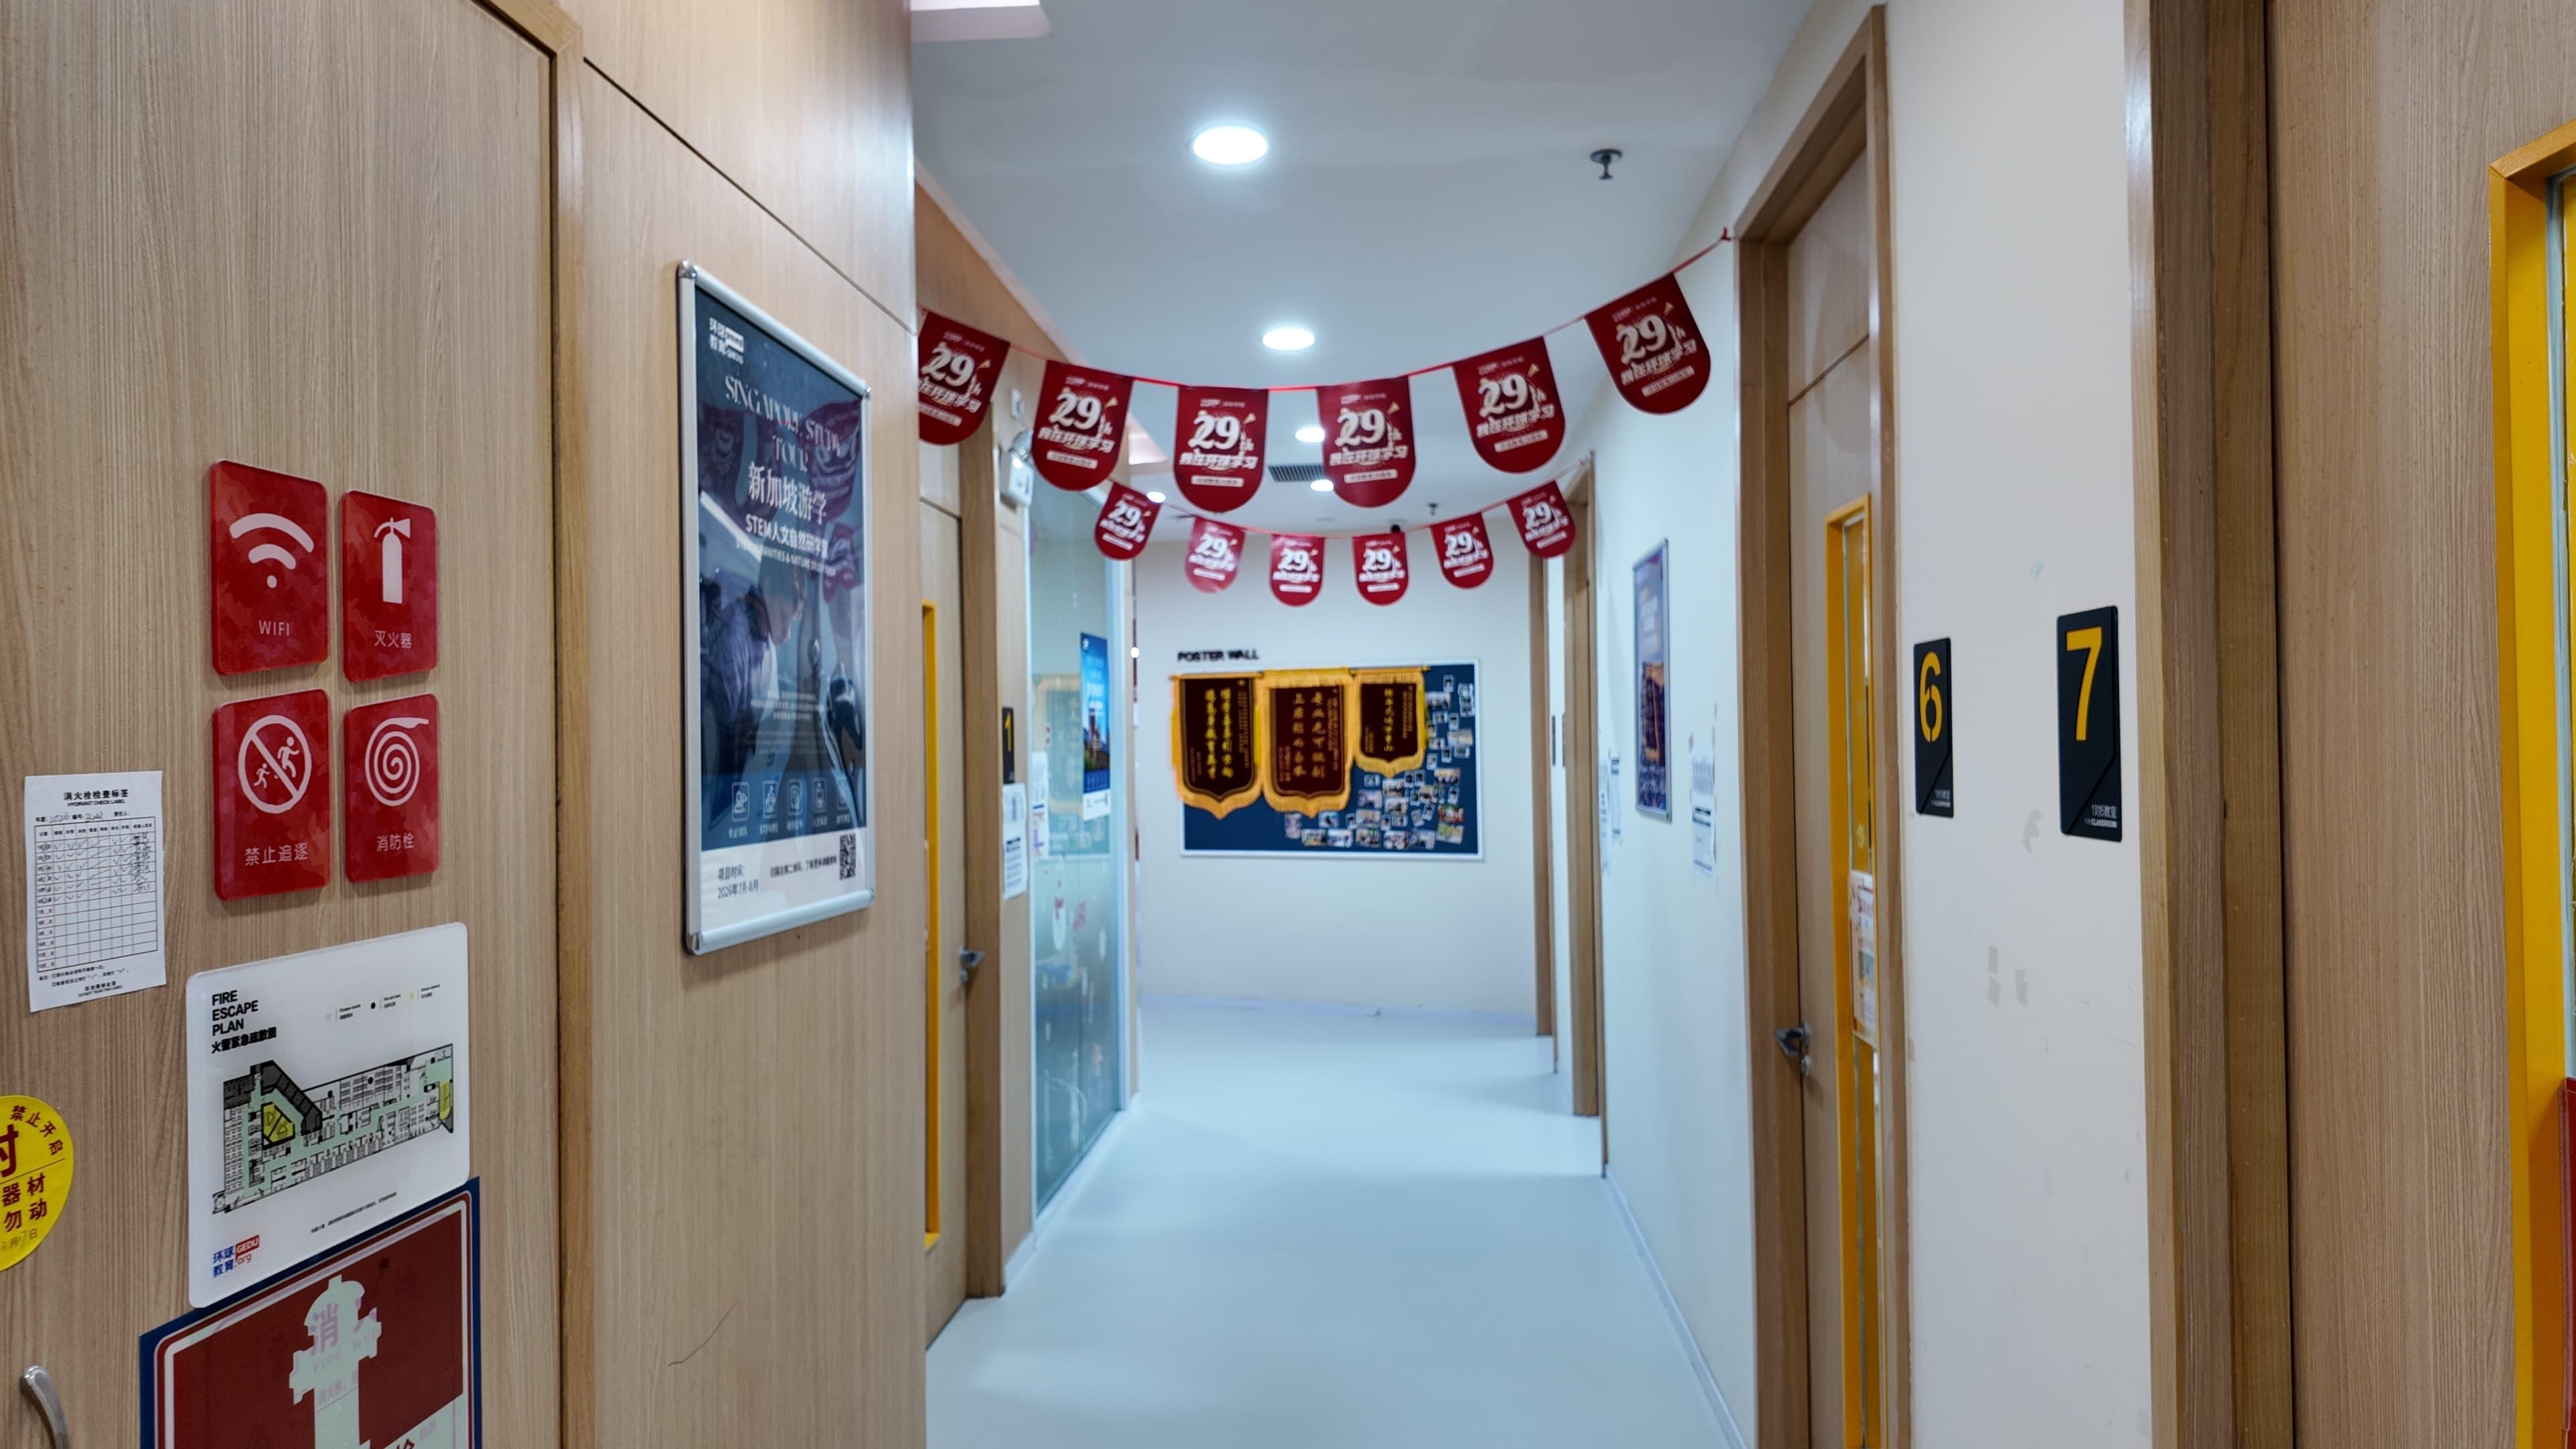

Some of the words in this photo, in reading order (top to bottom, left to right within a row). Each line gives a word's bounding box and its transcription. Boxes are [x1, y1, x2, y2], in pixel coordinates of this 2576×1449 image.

[918, 378, 982, 413] 在环球学习
[773, 435, 808, 472] TOUR
[748, 460, 827, 525] 新加坡游学
[258, 620, 290, 637] WIFI
[374, 630, 413, 649] 灭火器
[1177, 649, 1225, 663] POSTER
[1227, 649, 1260, 661] WALL
[2066, 627, 2102, 741] 7
[1920, 651, 1943, 743] 6
[1005, 712, 1013, 752] 1
[64, 789, 129, 801] 消火栓检查标签
[376, 833, 415, 852] 消防栓
[244, 843, 309, 867] 禁止追逐
[212, 989, 238, 1006] FIRE
[212, 1000, 259, 1022] ESCAPE
[212, 1018, 244, 1036] PLAN
[10, 1104, 64, 1156] 禁止开启
[2, 1172, 46, 1207] 器材
[4, 1197, 48, 1232] 勿动
[237, 1236, 259, 1253] GEDU
